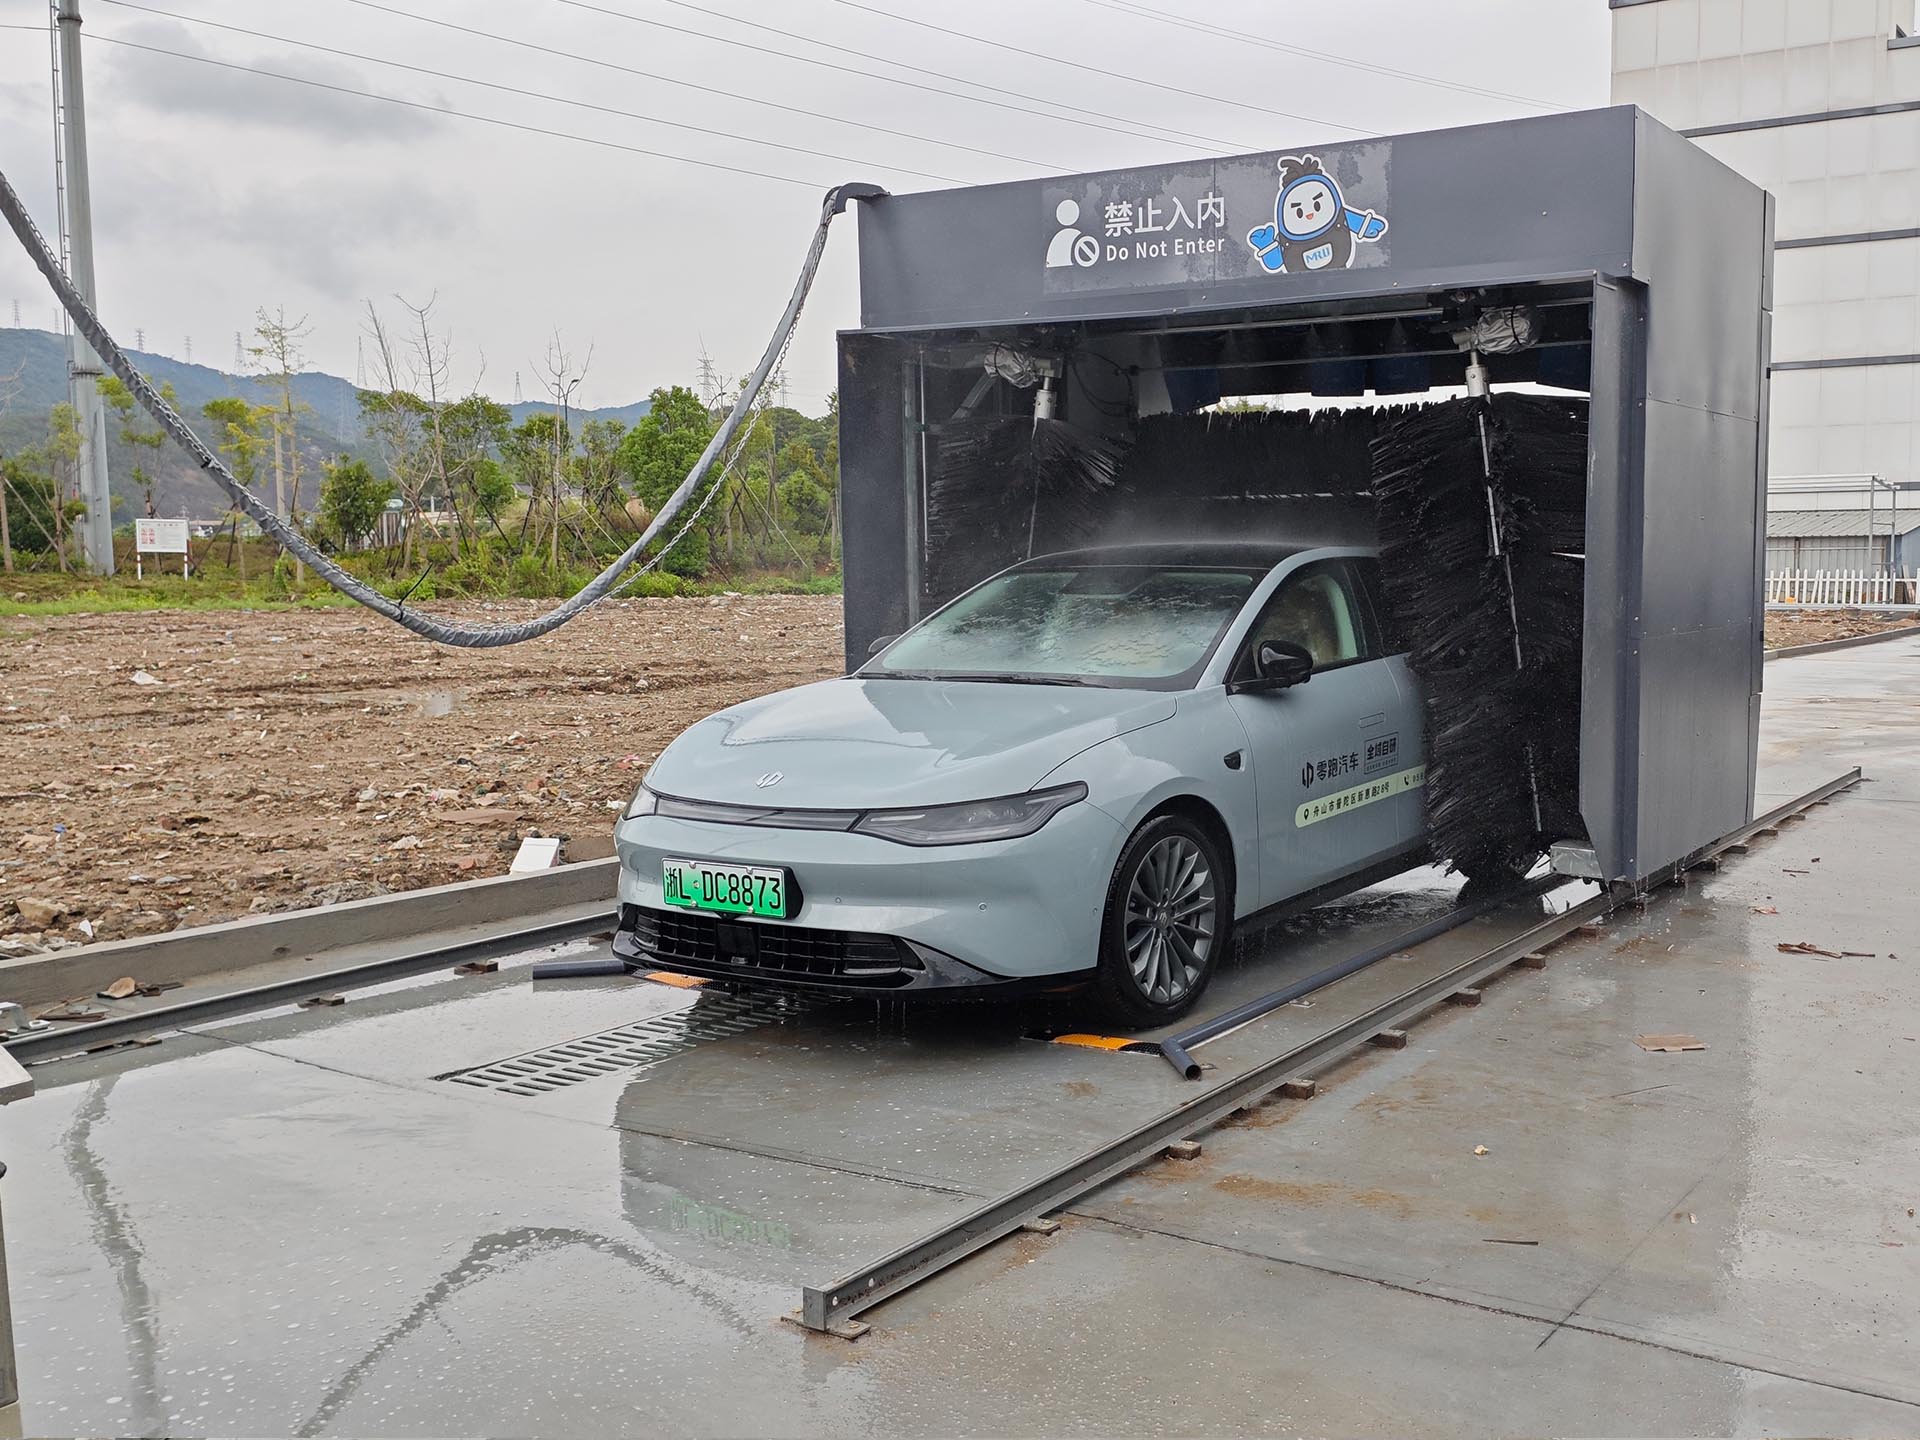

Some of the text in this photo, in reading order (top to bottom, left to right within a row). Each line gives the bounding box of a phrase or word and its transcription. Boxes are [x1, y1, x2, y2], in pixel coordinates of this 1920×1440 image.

[1104, 192, 1225, 238] 禁止入内
[1106, 236, 1225, 262] Do Not Enter
[1316, 751, 1359, 782] 零跑汽车
